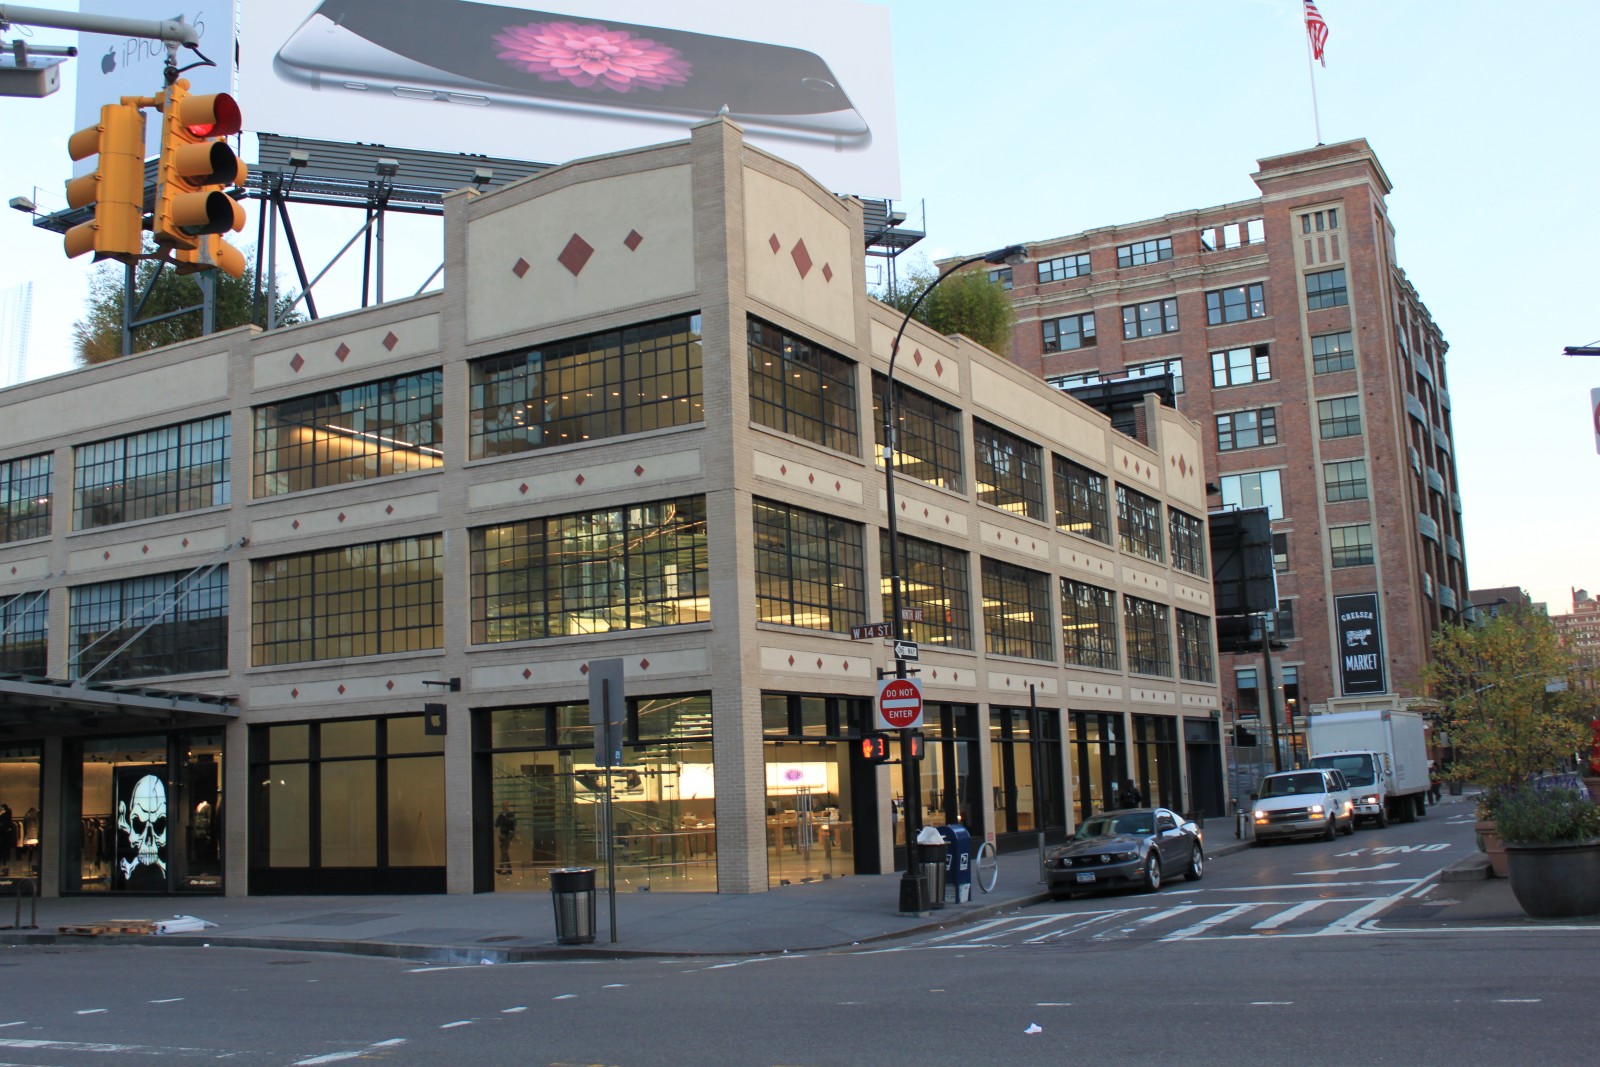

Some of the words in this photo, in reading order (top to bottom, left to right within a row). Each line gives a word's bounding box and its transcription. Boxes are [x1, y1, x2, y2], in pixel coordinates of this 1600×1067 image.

[122, 36, 176, 68] iPho
[193, 11, 205, 40] 6
[915, 610, 923, 622] AVE
[1341, 611, 1373, 621] CHELSEA
[852, 628, 860, 639] W
[864, 627, 874, 638] 14
[878, 624, 889, 636] ST
[897, 646, 905, 655] ONE
[907, 647, 916, 655] WAY
[1345, 653, 1377, 672] MARKET
[886, 689, 897, 697] DO
[899, 688, 914, 697] NOT
[889, 710, 913, 719] ENTER
[1333, 843, 1452, 857] ONLY
